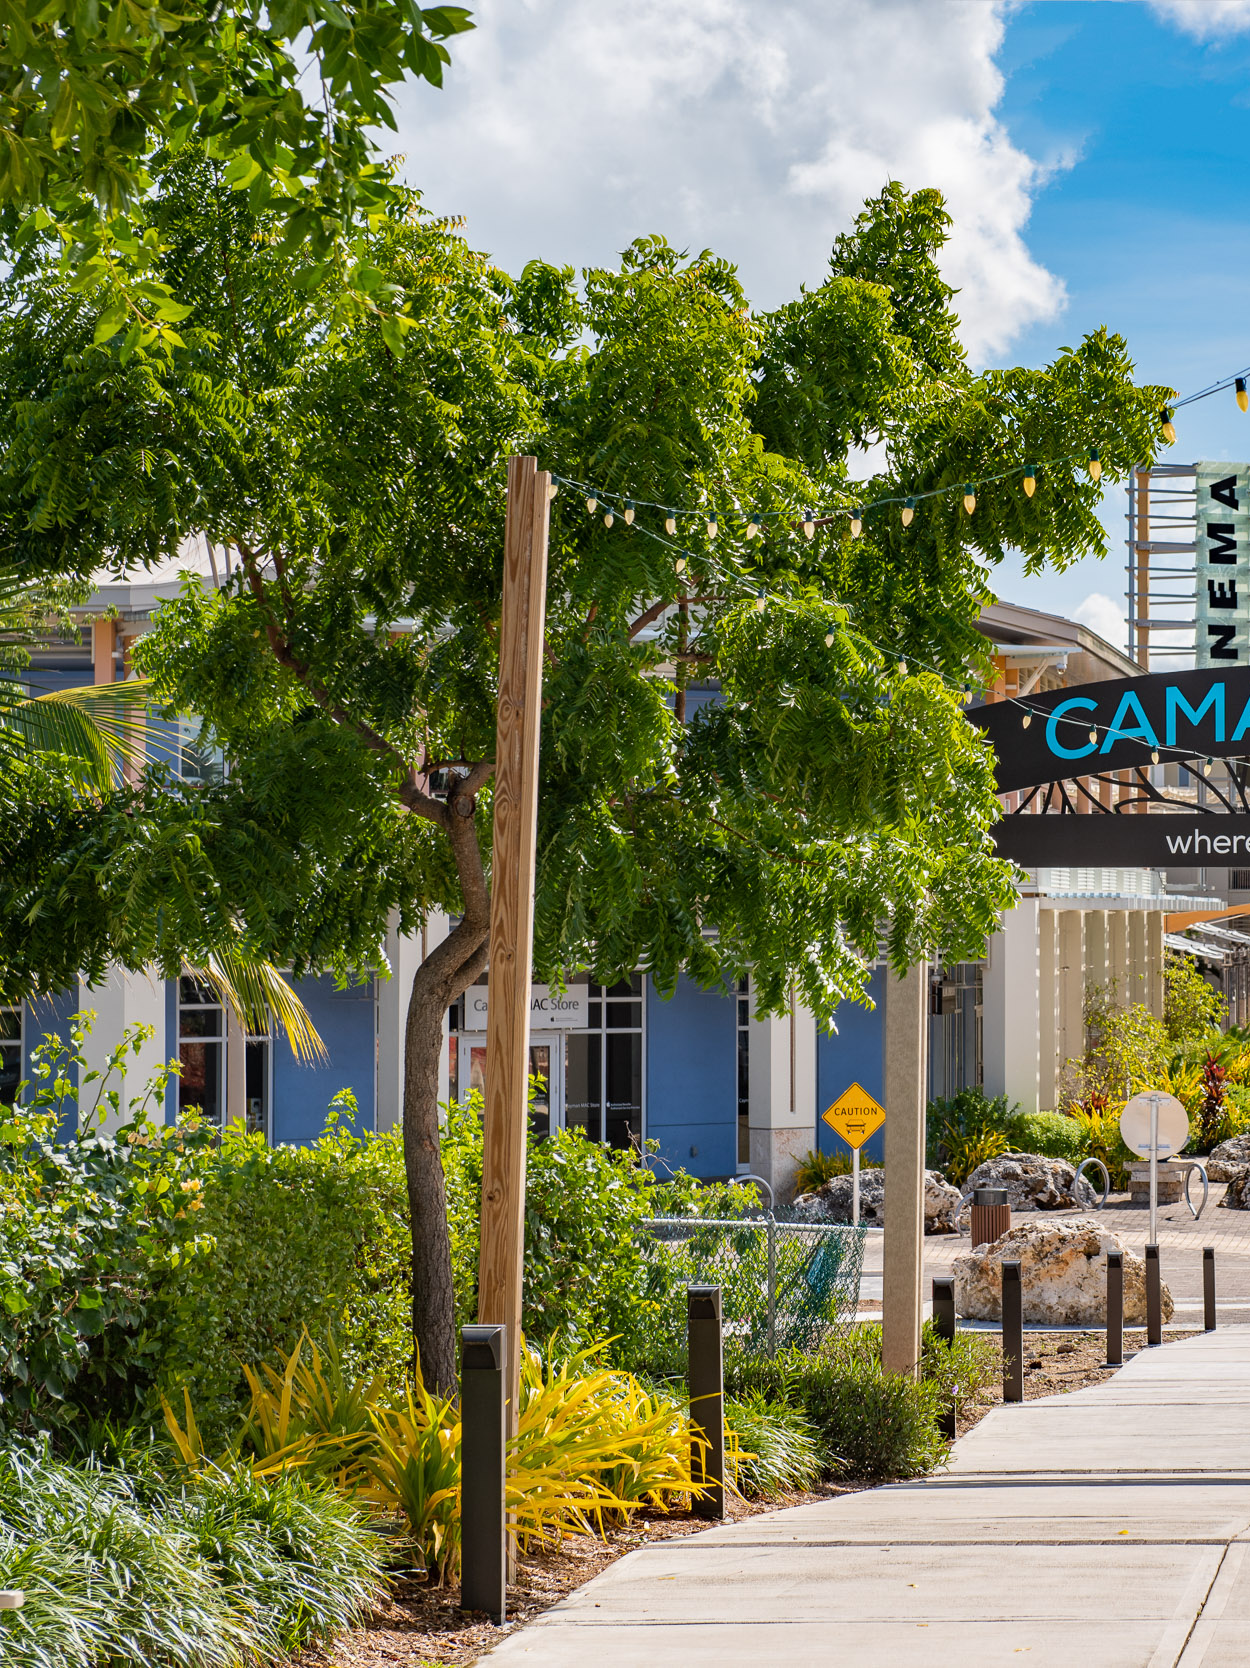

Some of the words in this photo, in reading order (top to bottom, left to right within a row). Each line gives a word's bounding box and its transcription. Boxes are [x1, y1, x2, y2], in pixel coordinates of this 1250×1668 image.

[530, 998, 548, 1011] AC
[550, 998, 579, 1011] Store
[834, 1107, 878, 1116] CAUTION
